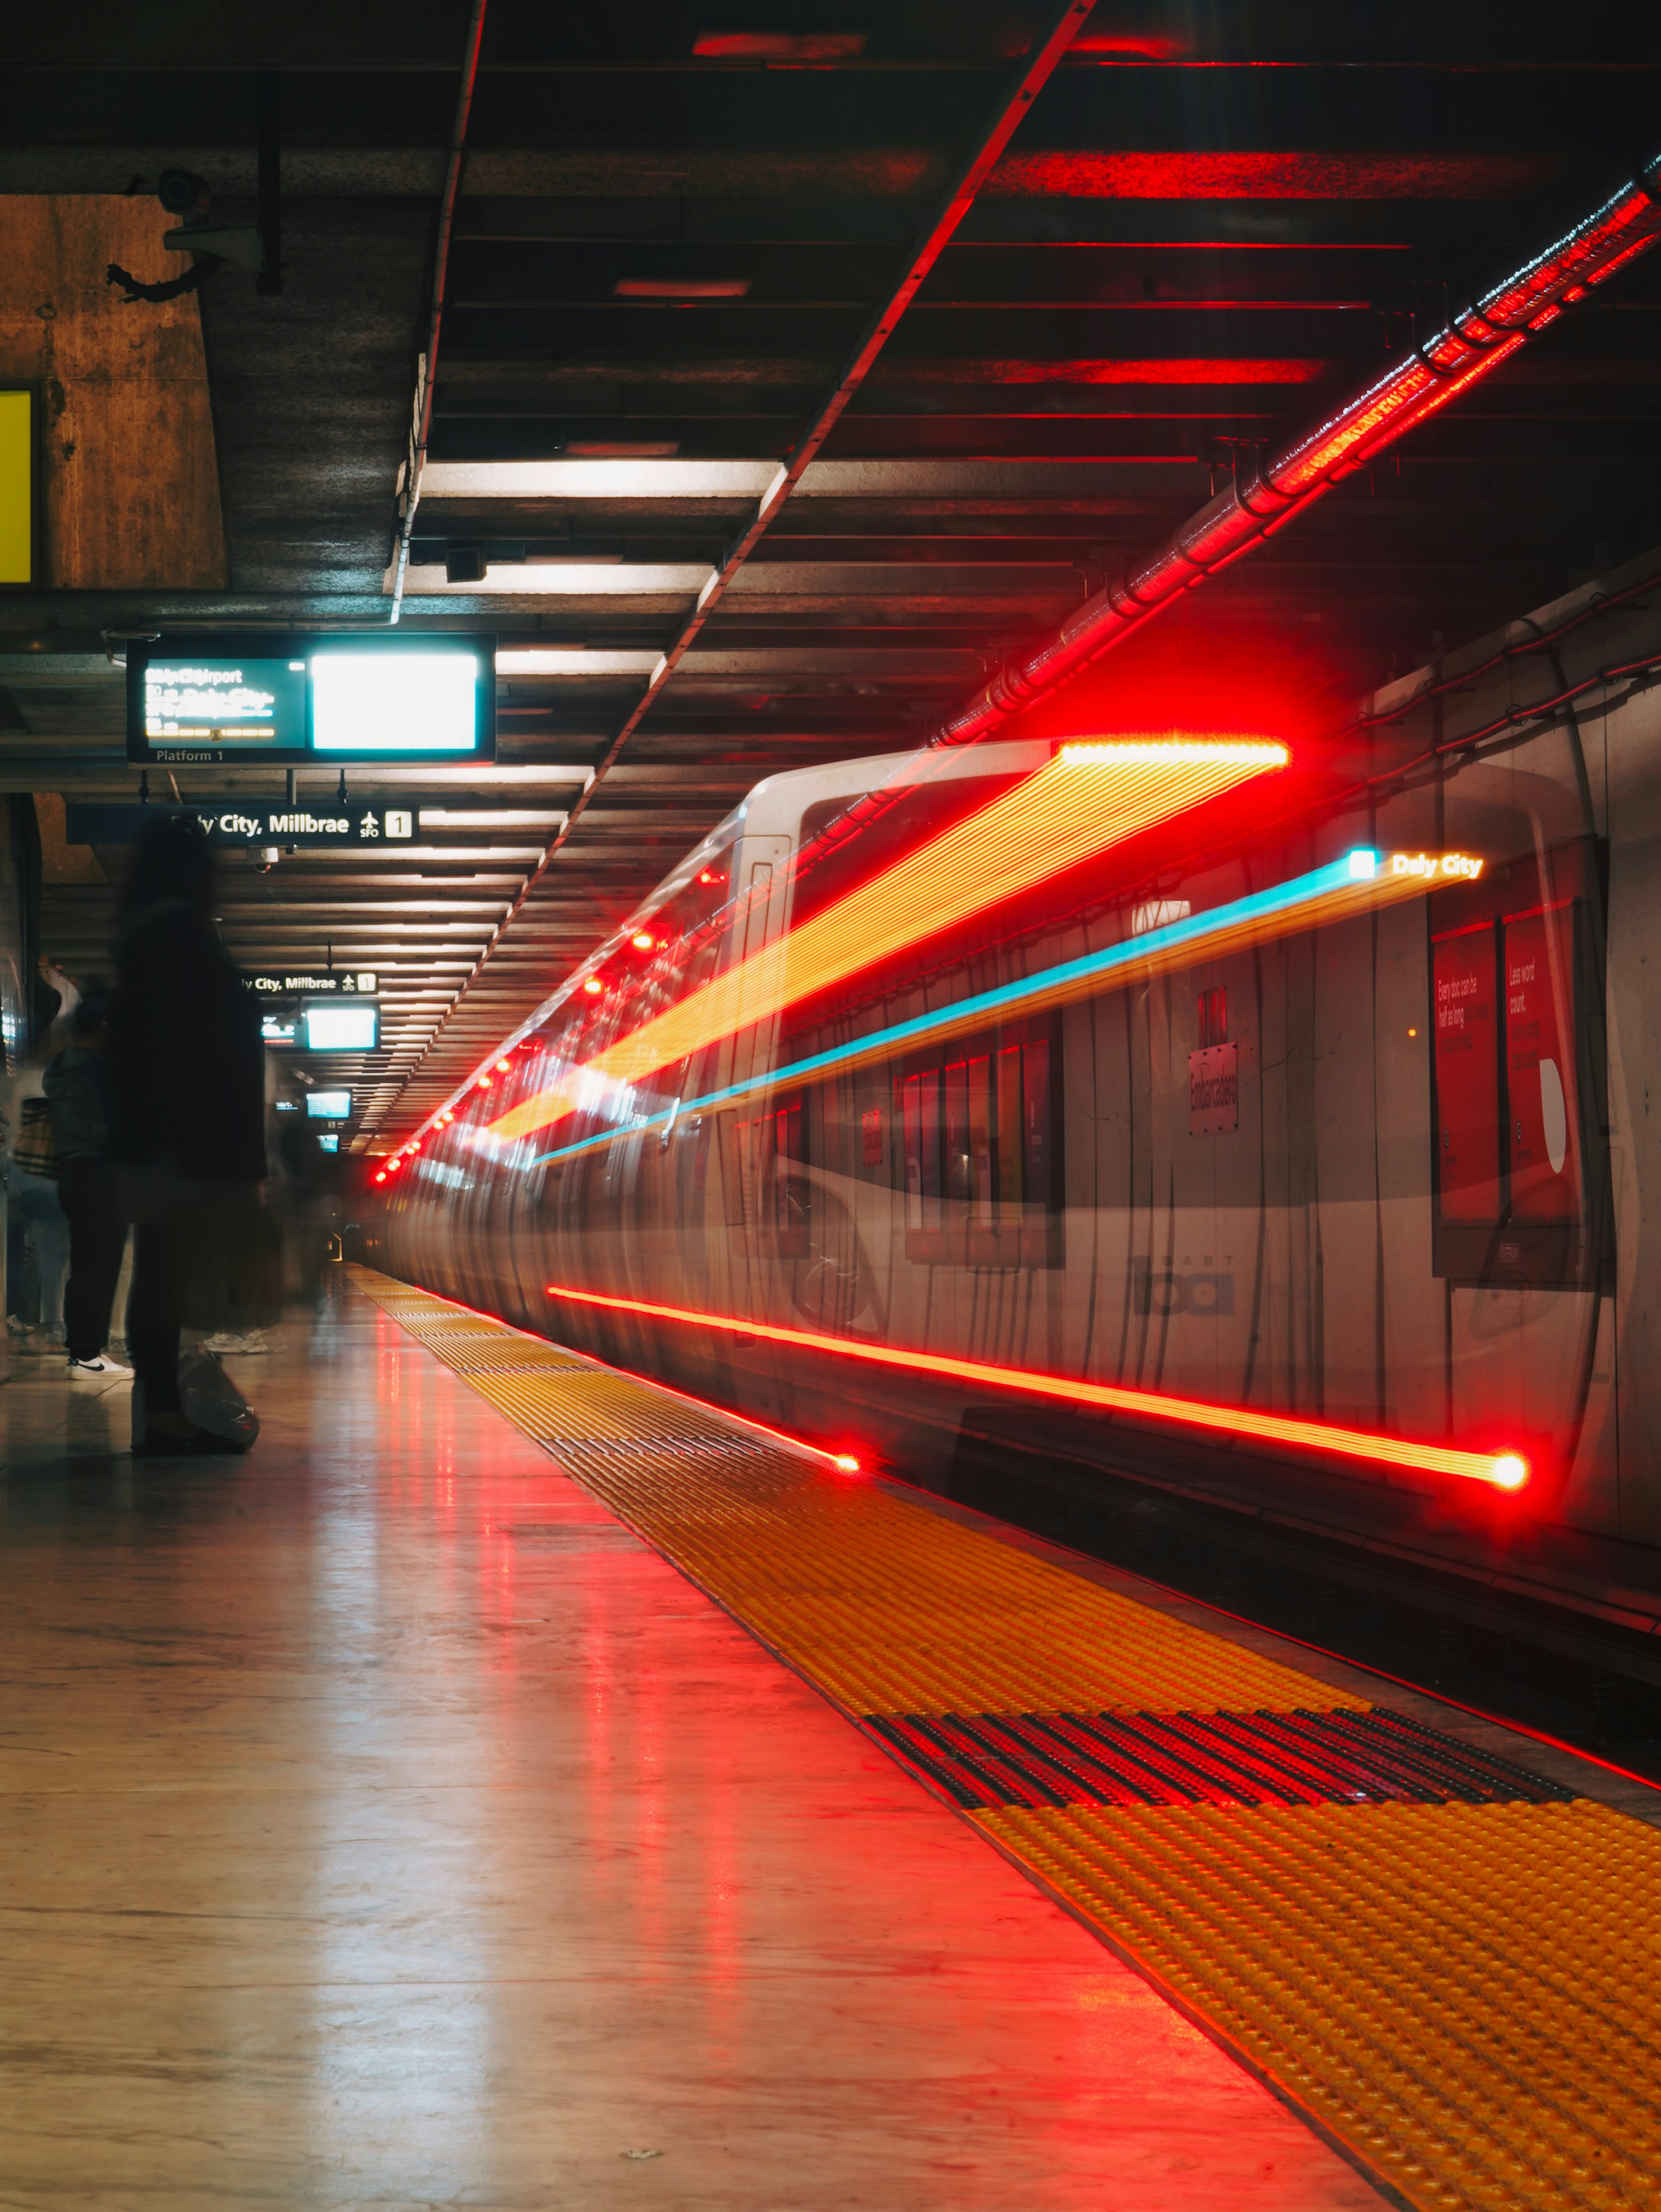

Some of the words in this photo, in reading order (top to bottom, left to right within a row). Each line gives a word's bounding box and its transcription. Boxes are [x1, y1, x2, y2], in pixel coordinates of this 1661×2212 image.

[157, 750, 211, 761] Platform
[218, 751, 223, 760] 1
[220, 814, 263, 837] City,
[269, 814, 349, 833] Millbrae
[360, 829, 379, 838] SFO
[1393, 854, 1438, 878] Daly
[1442, 854, 1484, 879] City
[255, 978, 283, 992] City,
[285, 977, 337, 989] Millbrae
[1510, 964, 1520, 986] Less
[1521, 958, 1534, 983] word
[1438, 980, 1450, 1004] Every
[1451, 976, 1460, 998] doc
[1460, 979, 1470, 996] can
[1470, 972, 1477, 994] be
[1448, 1010, 1453, 1026] as
[1453, 1003, 1464, 1030] long
[1191, 1063, 1236, 1112] Embarcadero
[1163, 1255, 1233, 1266] BART
